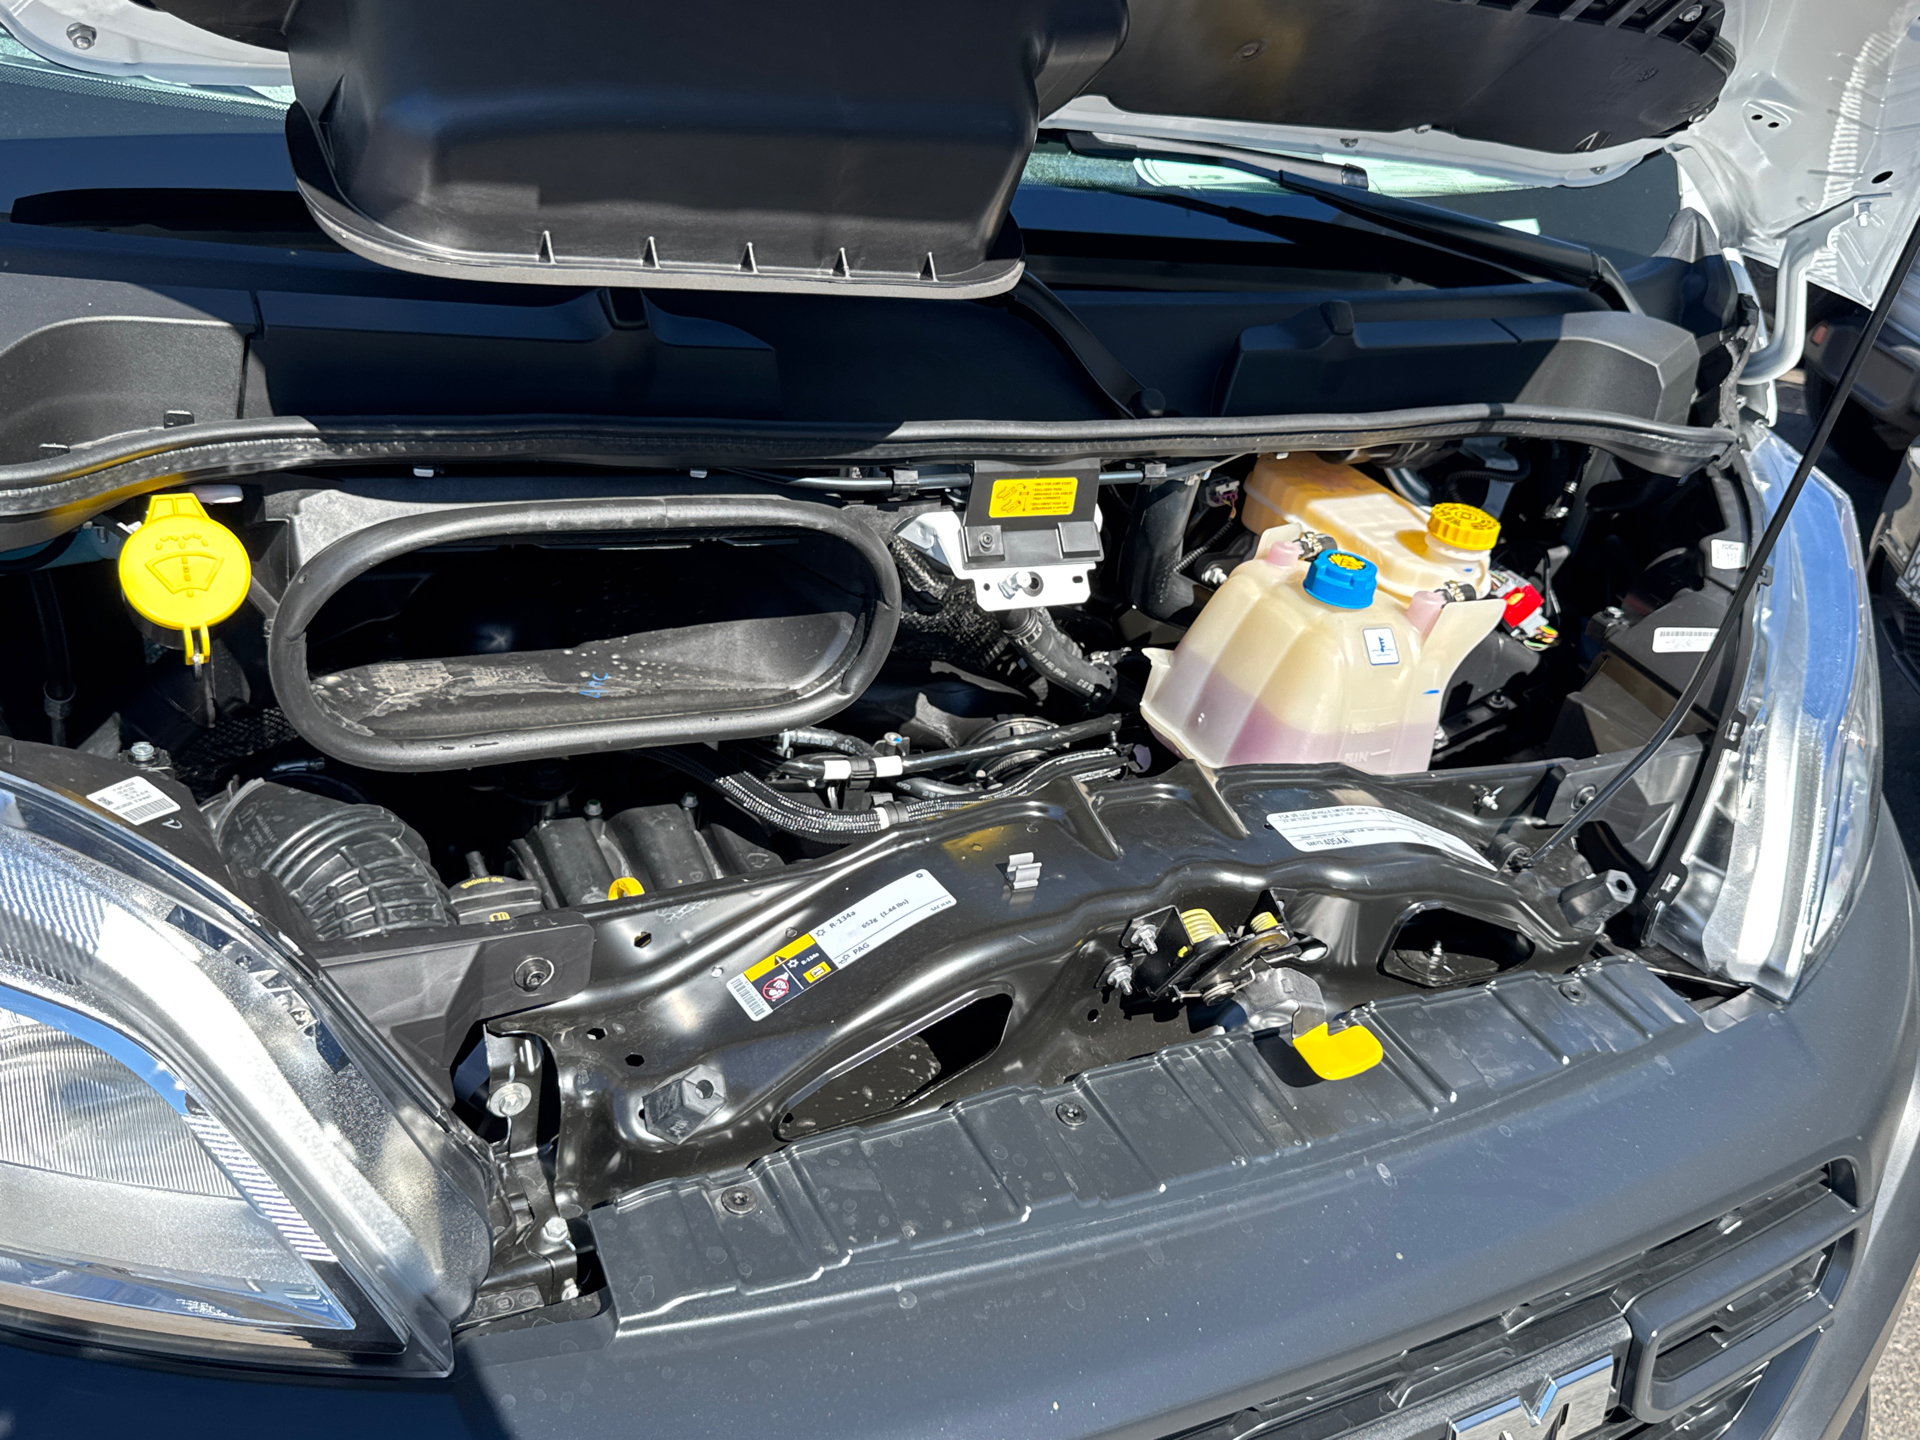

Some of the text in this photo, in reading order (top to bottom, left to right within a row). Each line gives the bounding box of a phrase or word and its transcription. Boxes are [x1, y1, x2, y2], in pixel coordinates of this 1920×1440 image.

[1344, 751, 1369, 763] MIN
[460, 876, 490, 889] ENGINE
[828, 910, 856, 929] R-134a
[861, 917, 879, 929] 652g
[896, 898, 910, 909] lbs)
[852, 942, 870, 955] PAG
